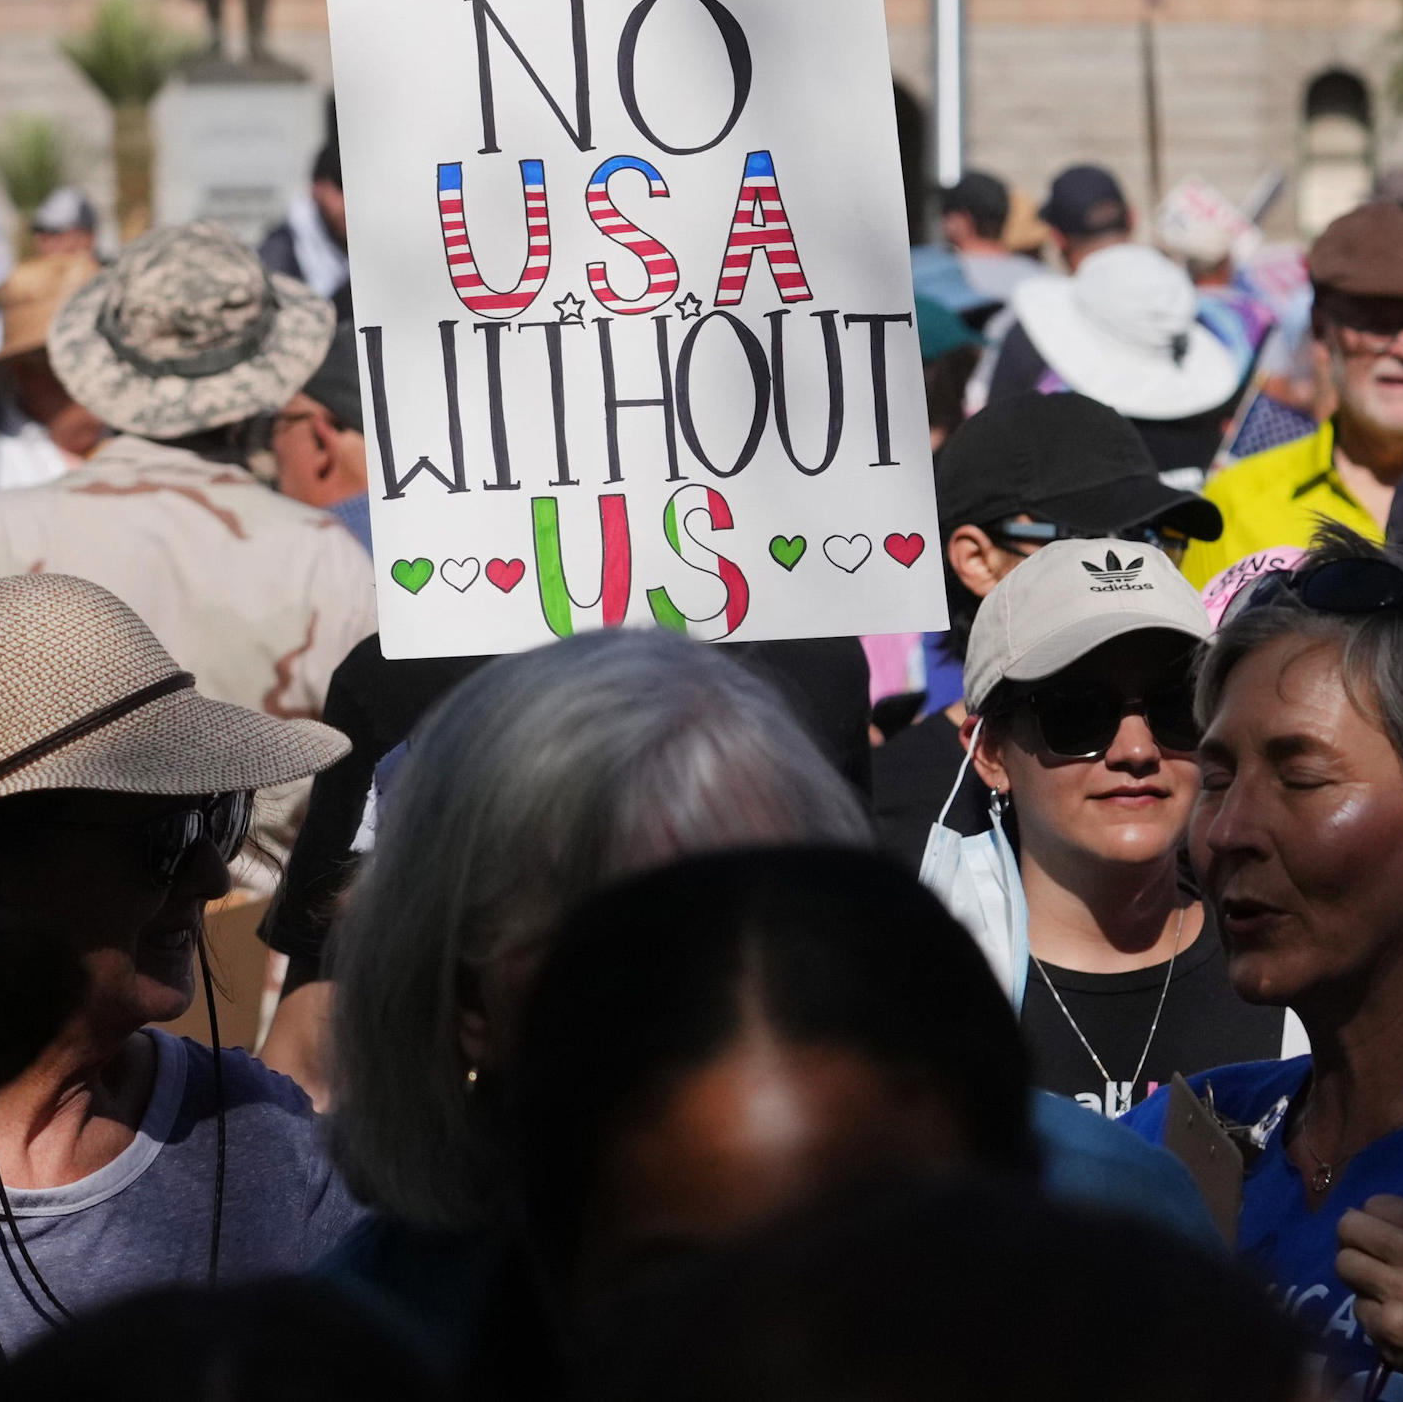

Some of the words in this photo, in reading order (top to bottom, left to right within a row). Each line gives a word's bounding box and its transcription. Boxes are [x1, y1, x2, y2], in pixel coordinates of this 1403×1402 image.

[358, 309, 912, 501] WITHOUT
[529, 482, 750, 643] US
[1090, 582, 1154, 593] adidas
